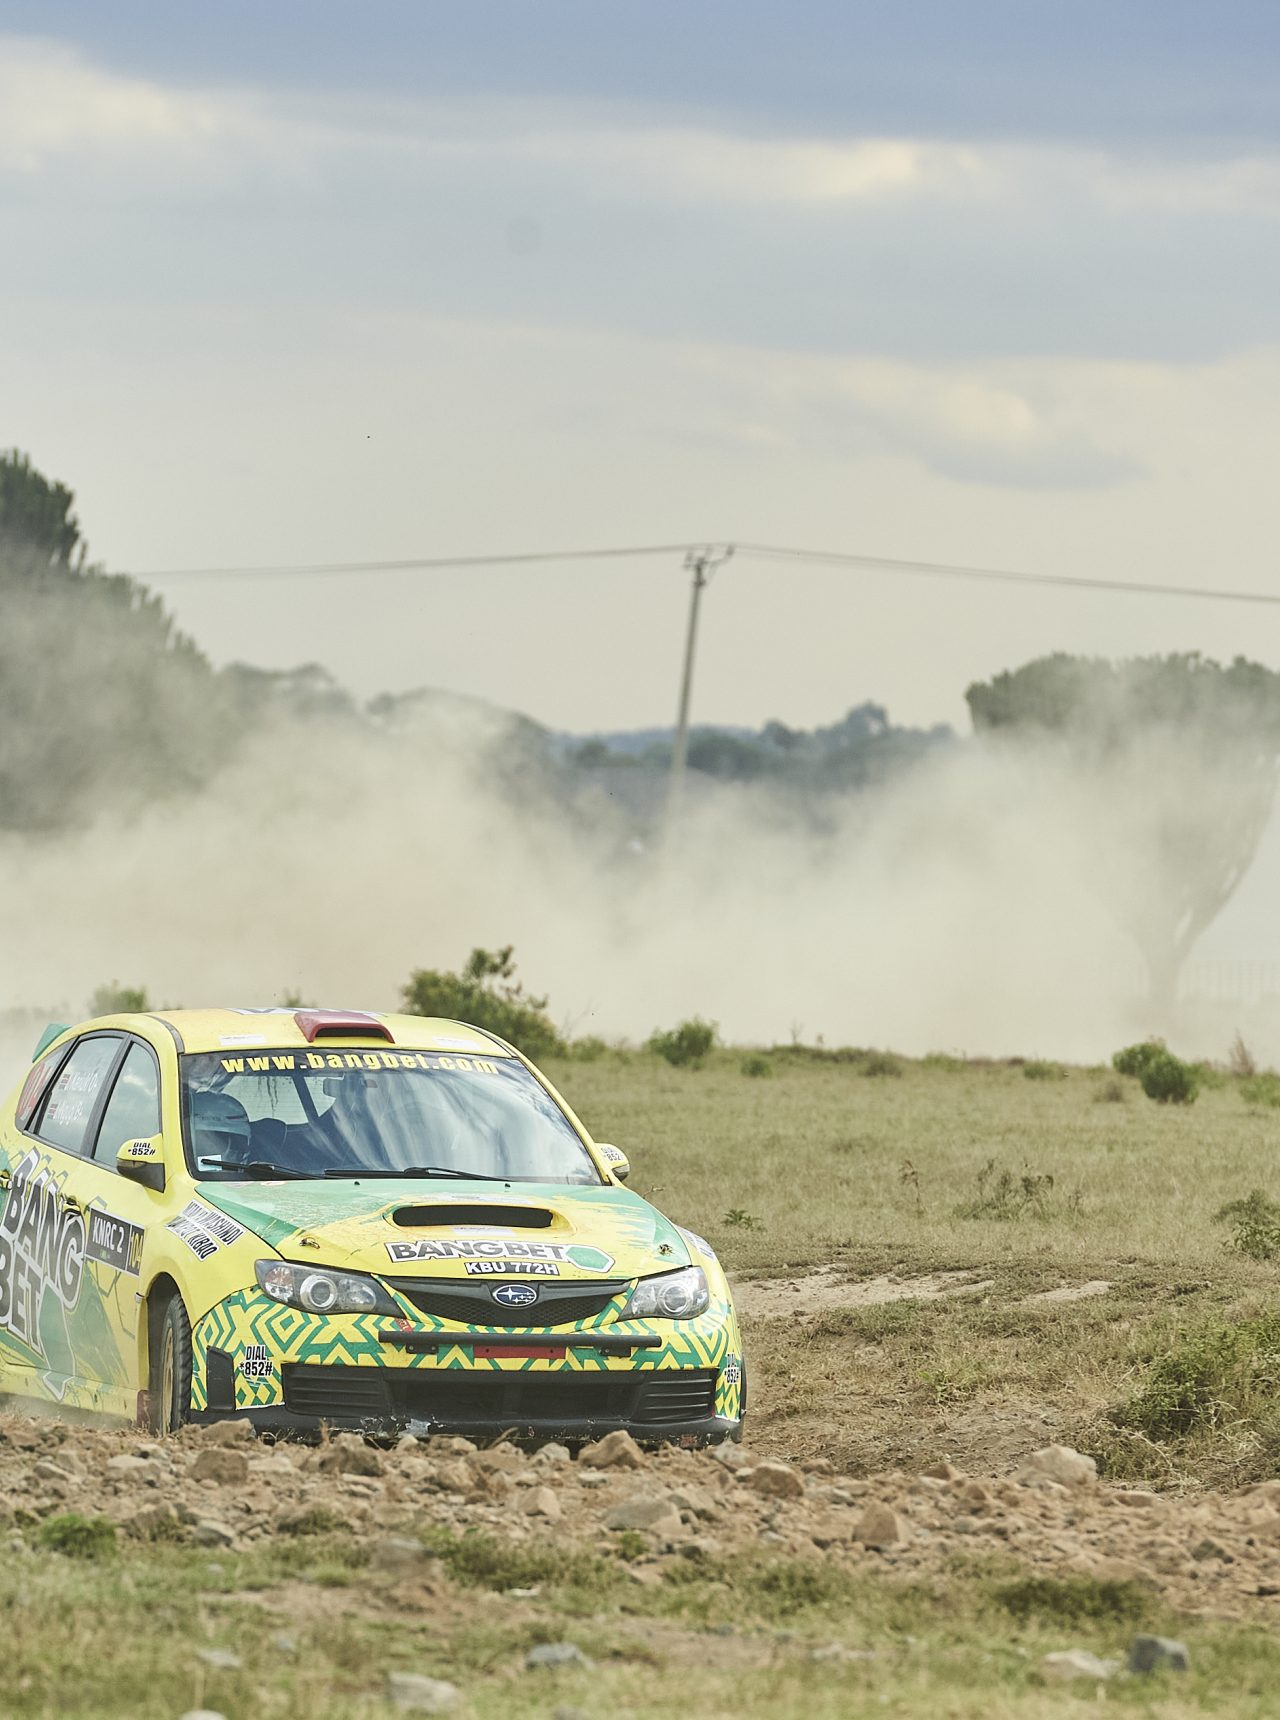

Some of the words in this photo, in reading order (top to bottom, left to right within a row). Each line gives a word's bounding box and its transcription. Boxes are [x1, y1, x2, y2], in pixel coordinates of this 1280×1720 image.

[221, 1053, 499, 1074] www.bangbet.com
[3, 1148, 85, 1311] BANG
[92, 1216, 117, 1251] KNRC
[116, 1226, 125, 1254] 2
[390, 1240, 565, 1261] BANGBET
[468, 1262, 506, 1274] KBU
[513, 1262, 559, 1275] 772H
[246, 1345, 266, 1361] DIAL
